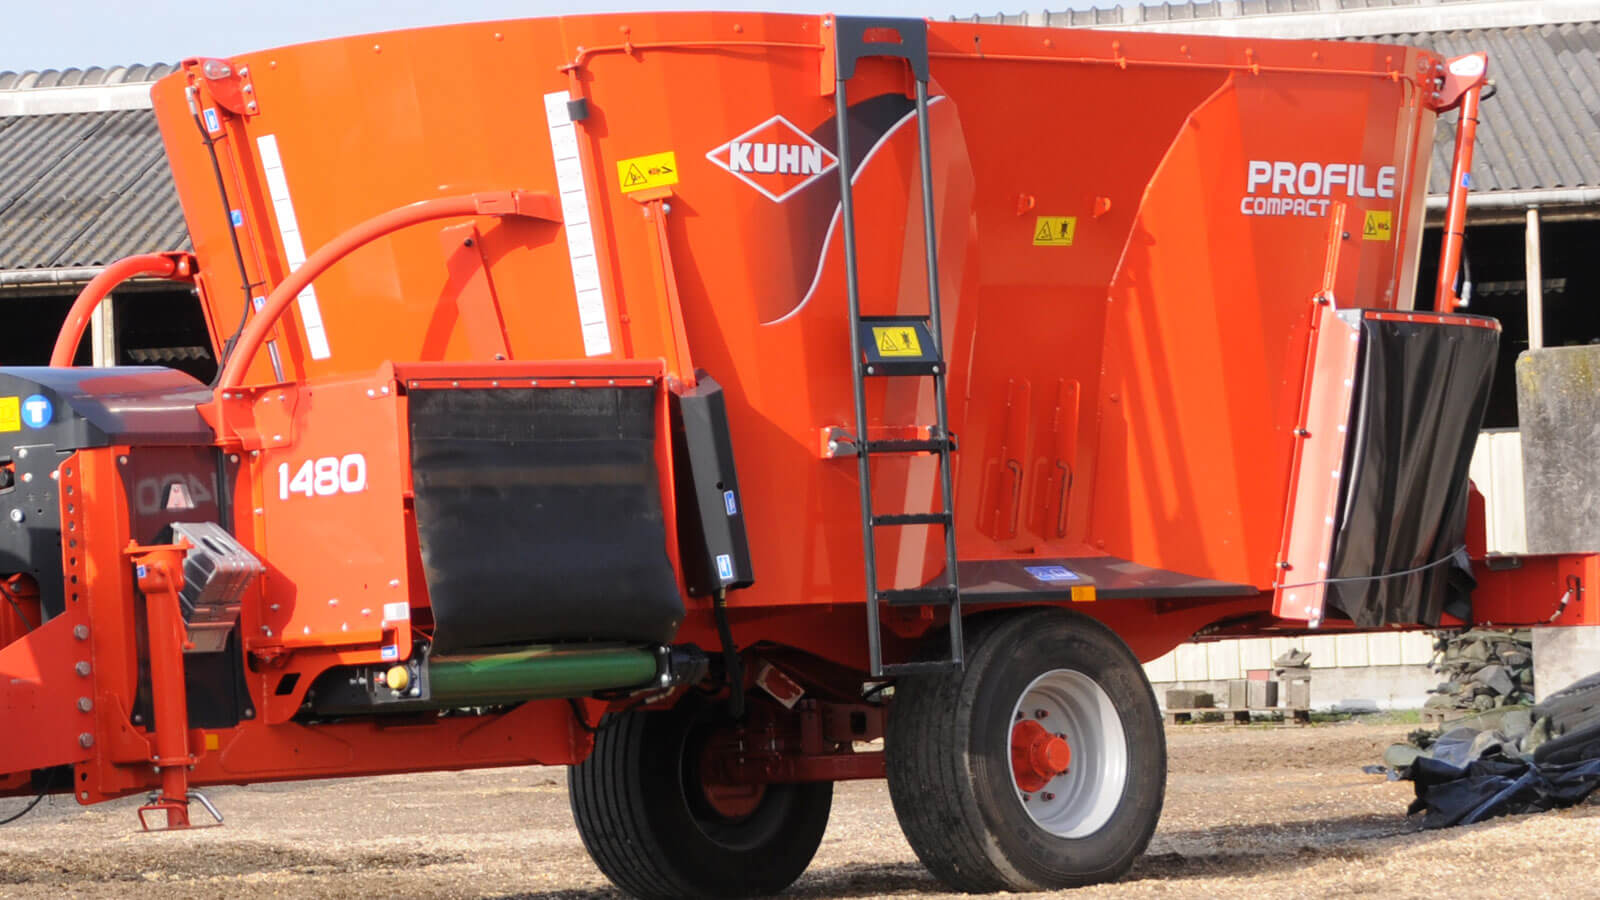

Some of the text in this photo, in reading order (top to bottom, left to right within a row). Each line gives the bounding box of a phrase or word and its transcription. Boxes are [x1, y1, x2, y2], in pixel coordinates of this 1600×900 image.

[729, 142, 822, 174] KUHN
[1247, 160, 1396, 198] PROFILE
[1240, 197, 1331, 216] COMPACT
[278, 453, 366, 500] 1480
